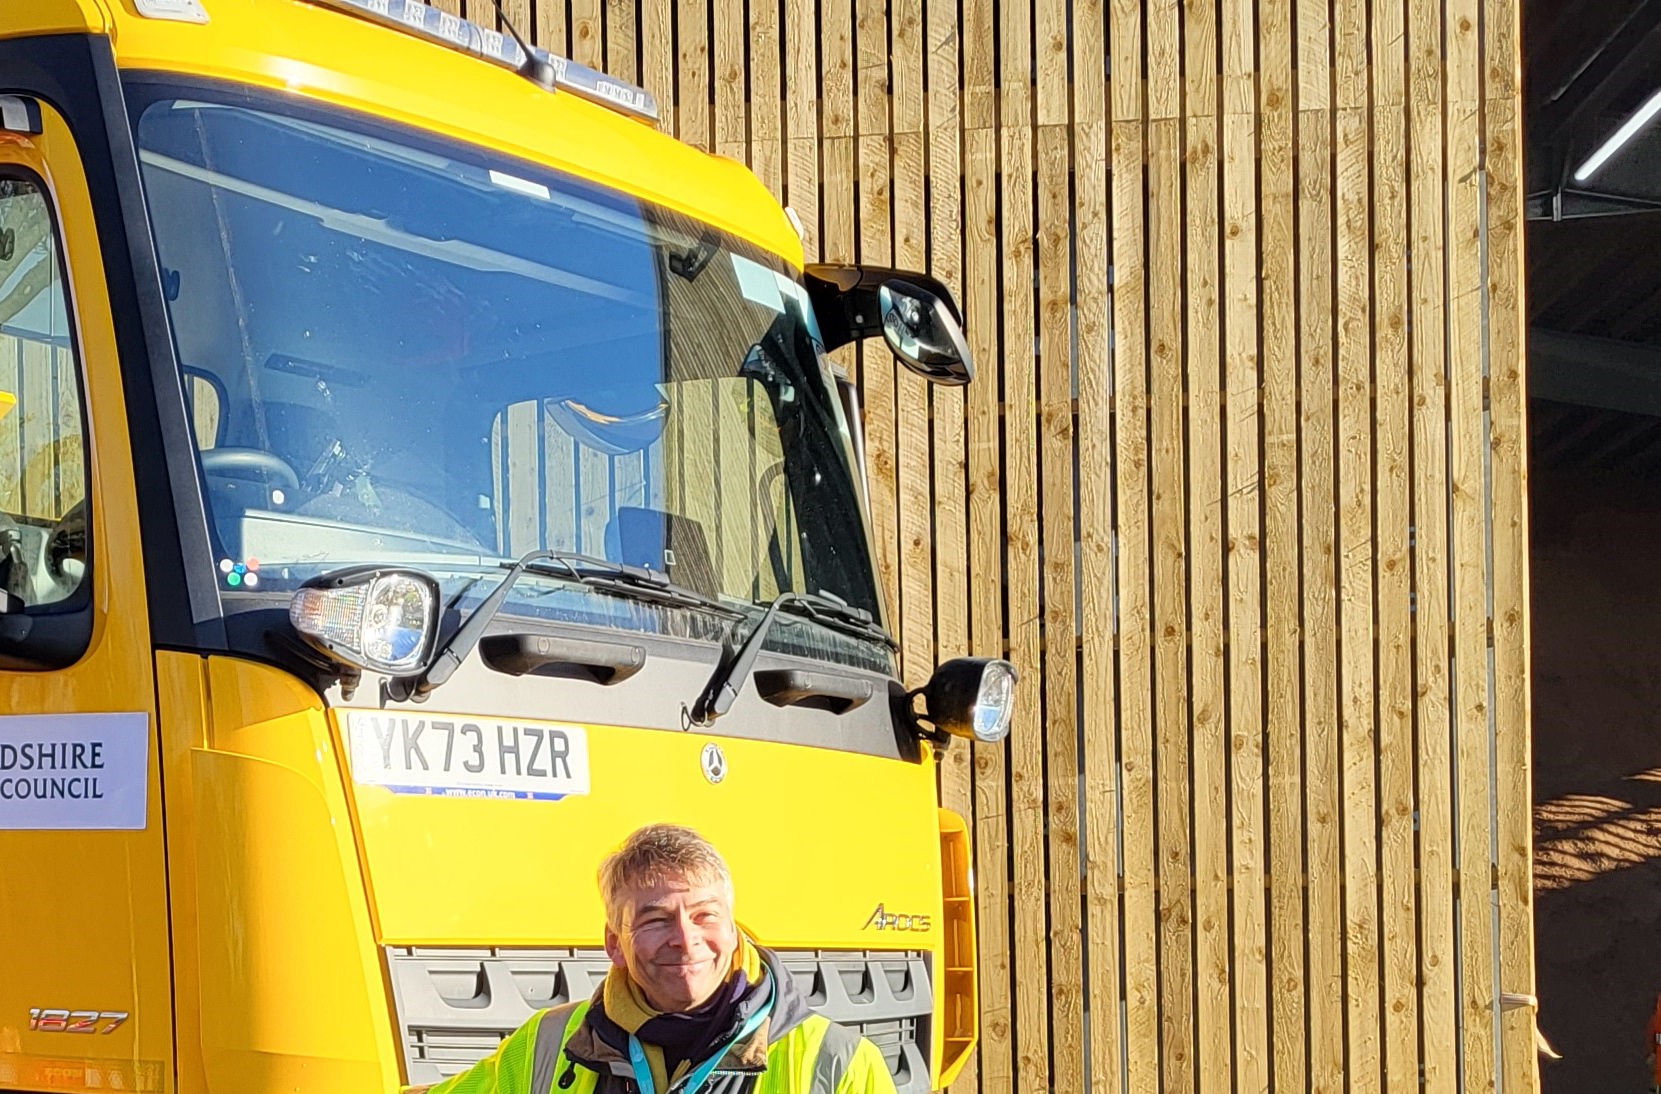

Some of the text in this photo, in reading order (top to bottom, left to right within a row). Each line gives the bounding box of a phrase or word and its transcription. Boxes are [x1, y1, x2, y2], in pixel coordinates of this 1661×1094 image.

[370, 717, 486, 774] YK73
[496, 724, 573, 780] HZR
[0, 777, 105, 800] COUNCIL
[29, 1007, 129, 1034] 1827
